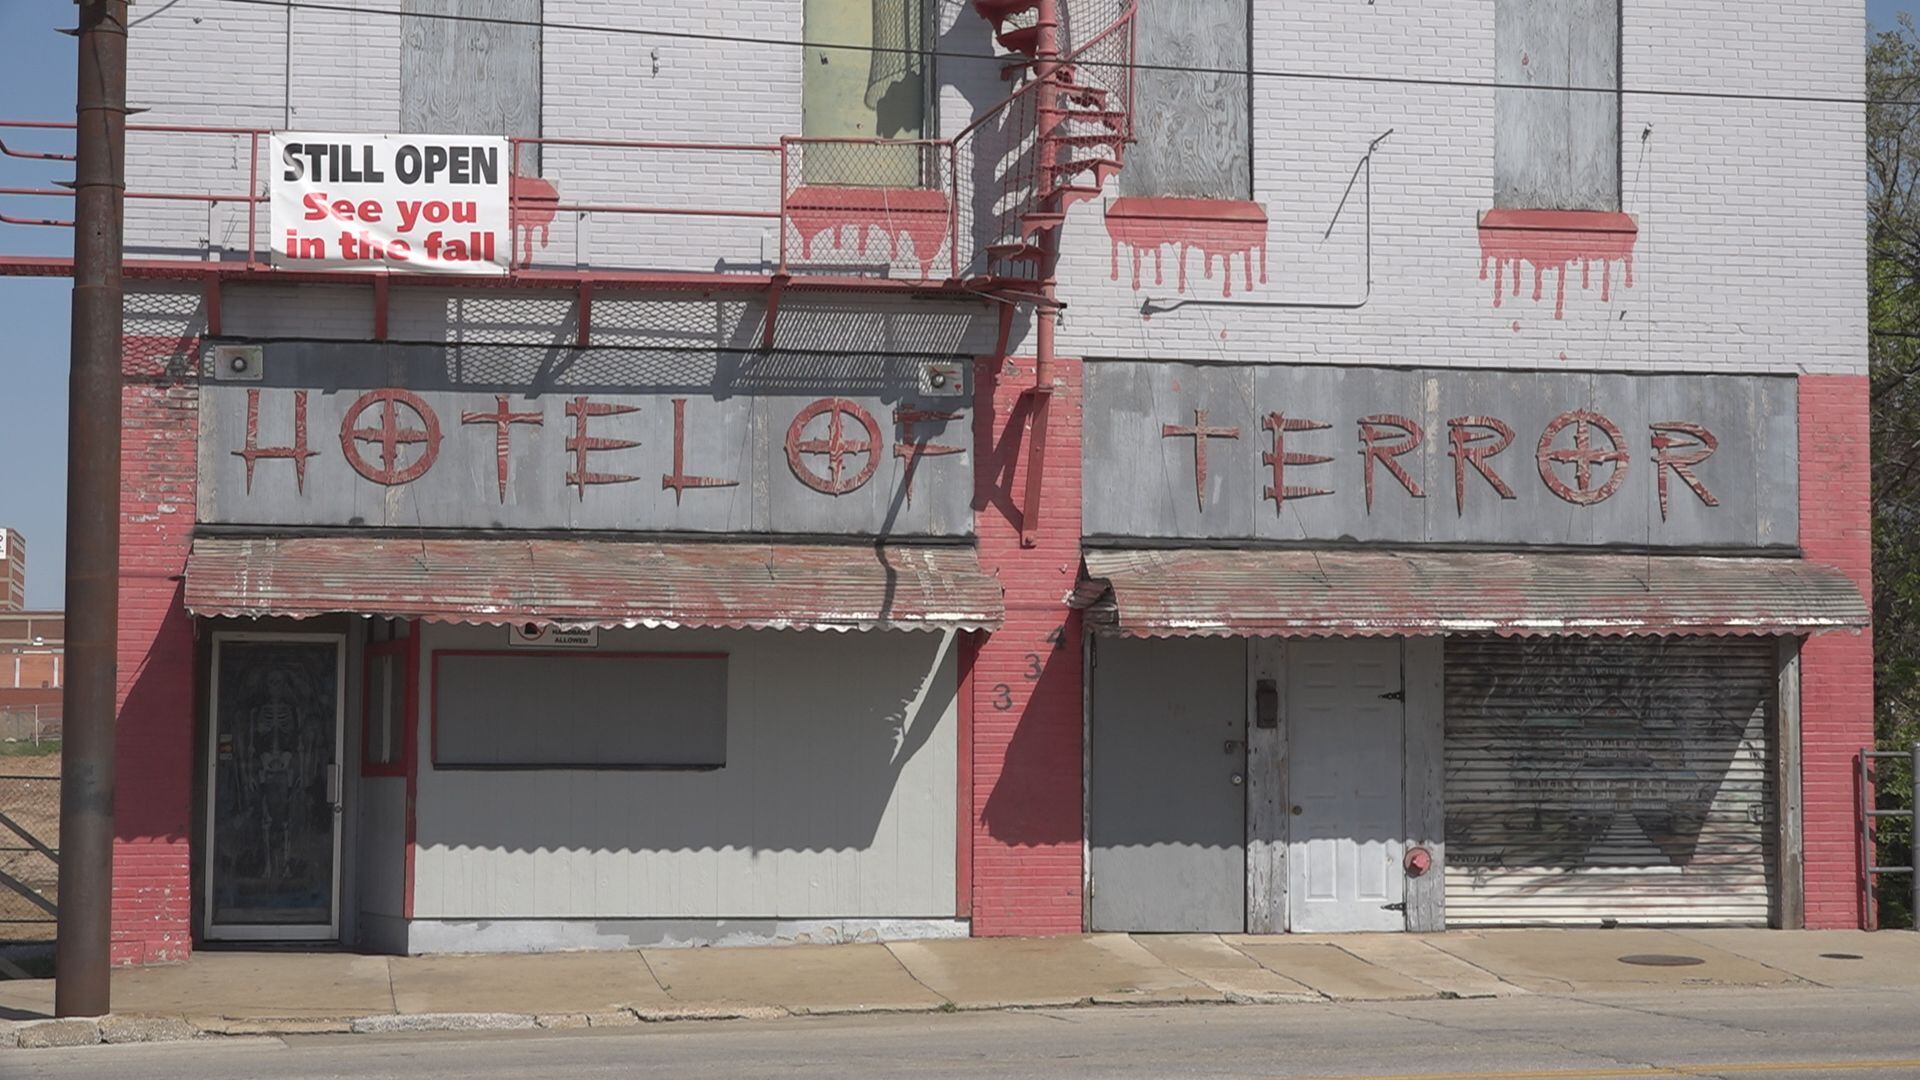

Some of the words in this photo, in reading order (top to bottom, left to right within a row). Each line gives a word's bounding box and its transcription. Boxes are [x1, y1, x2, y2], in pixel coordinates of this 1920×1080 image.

[282, 142, 384, 183] STILL
[395, 144, 498, 185] OPEN
[303, 192, 383, 222] See
[396, 200, 477, 233] you
[286, 229, 325, 260] in
[339, 230, 411, 261] the
[424, 231, 494, 262] fall
[231, 386, 740, 507] HOTEL
[784, 397, 967, 511] OF
[1162, 407, 1720, 524] TERROR
